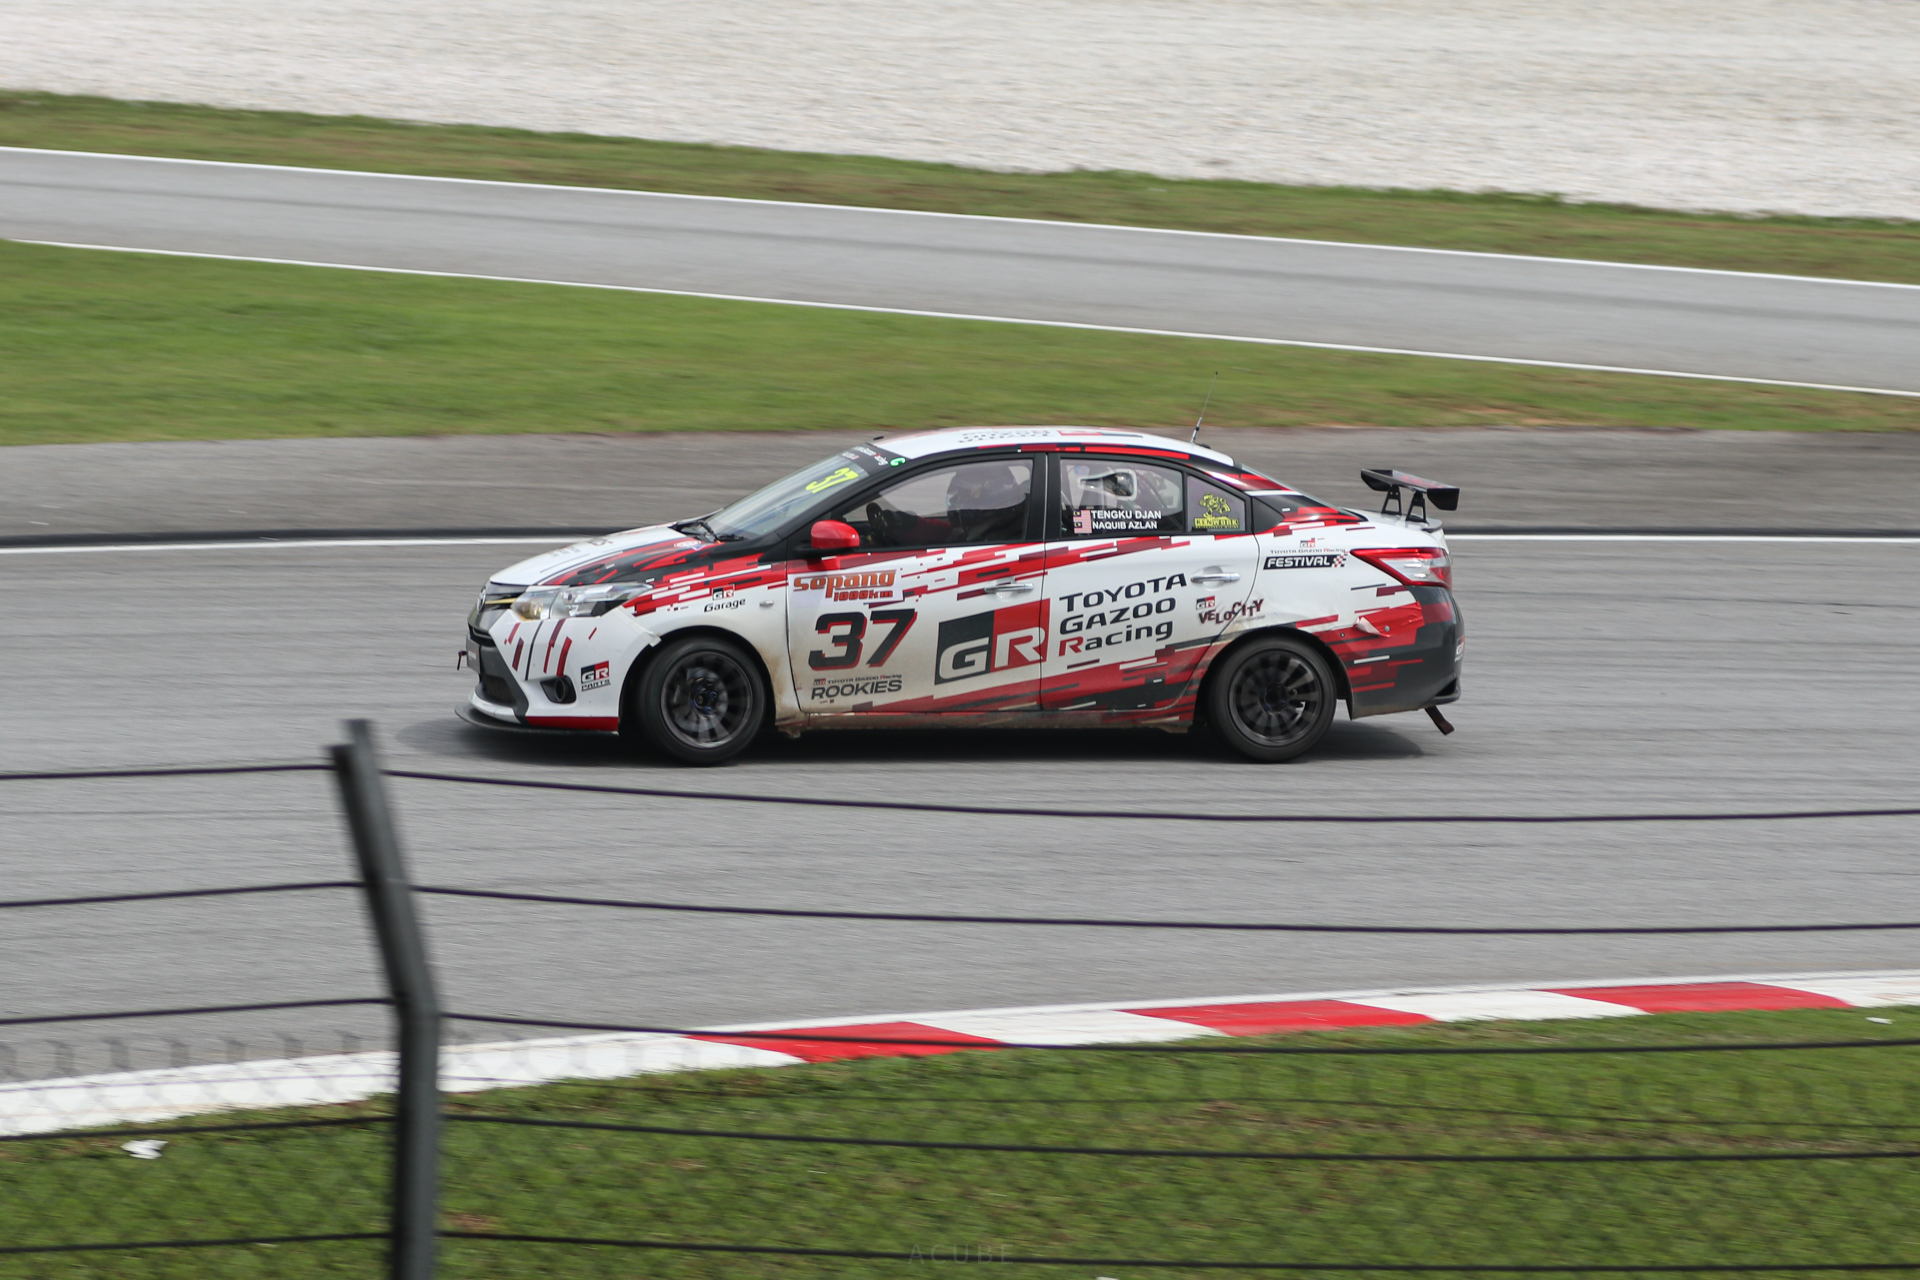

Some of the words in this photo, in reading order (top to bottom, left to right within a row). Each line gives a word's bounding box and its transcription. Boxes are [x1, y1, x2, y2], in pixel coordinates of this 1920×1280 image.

[805, 467, 859, 494] 37
[1091, 510, 1133, 519] TENGKU
[1135, 510, 1162, 519] DJAN
[1092, 521, 1127, 530] NAQUIB
[1128, 521, 1158, 530] AZLAN
[1267, 556, 1331, 569] FESTIVAL
[713, 588, 735, 600] GR
[1059, 573, 1187, 612] TOYOTA
[704, 599, 746, 613] Garage
[1196, 599, 1215, 610] GR
[1198, 598, 1264, 624] VELOCITY
[1059, 597, 1176, 636] GAZOO
[808, 608, 918, 671] 37
[1058, 621, 1174, 657] Racing
[938, 624, 1047, 681] GR
[581, 665, 609, 684] GR
[811, 680, 902, 700] ROOKIES
